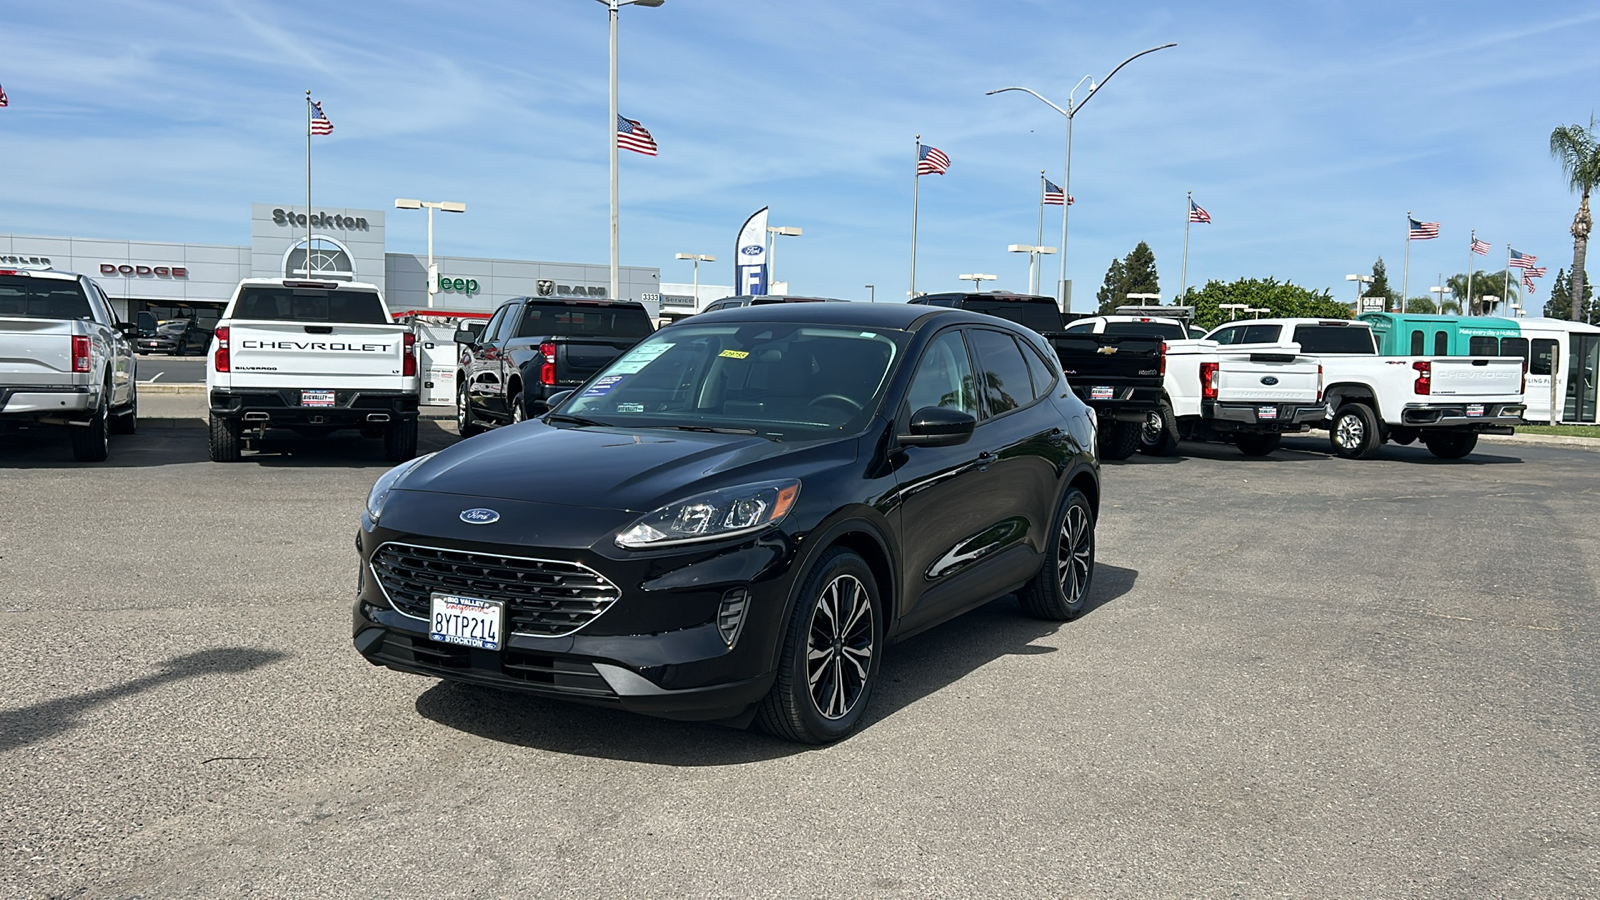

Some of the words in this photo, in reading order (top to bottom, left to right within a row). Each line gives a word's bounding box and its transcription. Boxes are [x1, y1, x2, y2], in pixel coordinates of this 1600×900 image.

[272, 208, 367, 230] Stockton
[100, 263, 187, 277] DODGE
[556, 285, 606, 296] RAM
[642, 293, 659, 301] 3333
[665, 296, 694, 304] Service
[1363, 298, 1383, 306] OEM
[242, 340, 392, 352] CHEVROLET
[1438, 371, 1518, 379] CHEVROLET
[447, 596, 459, 604] BIG
[460, 598, 485, 607] VALLEY
[435, 612, 496, 641] 8YTP214
[445, 635, 484, 647] STOCKTON
